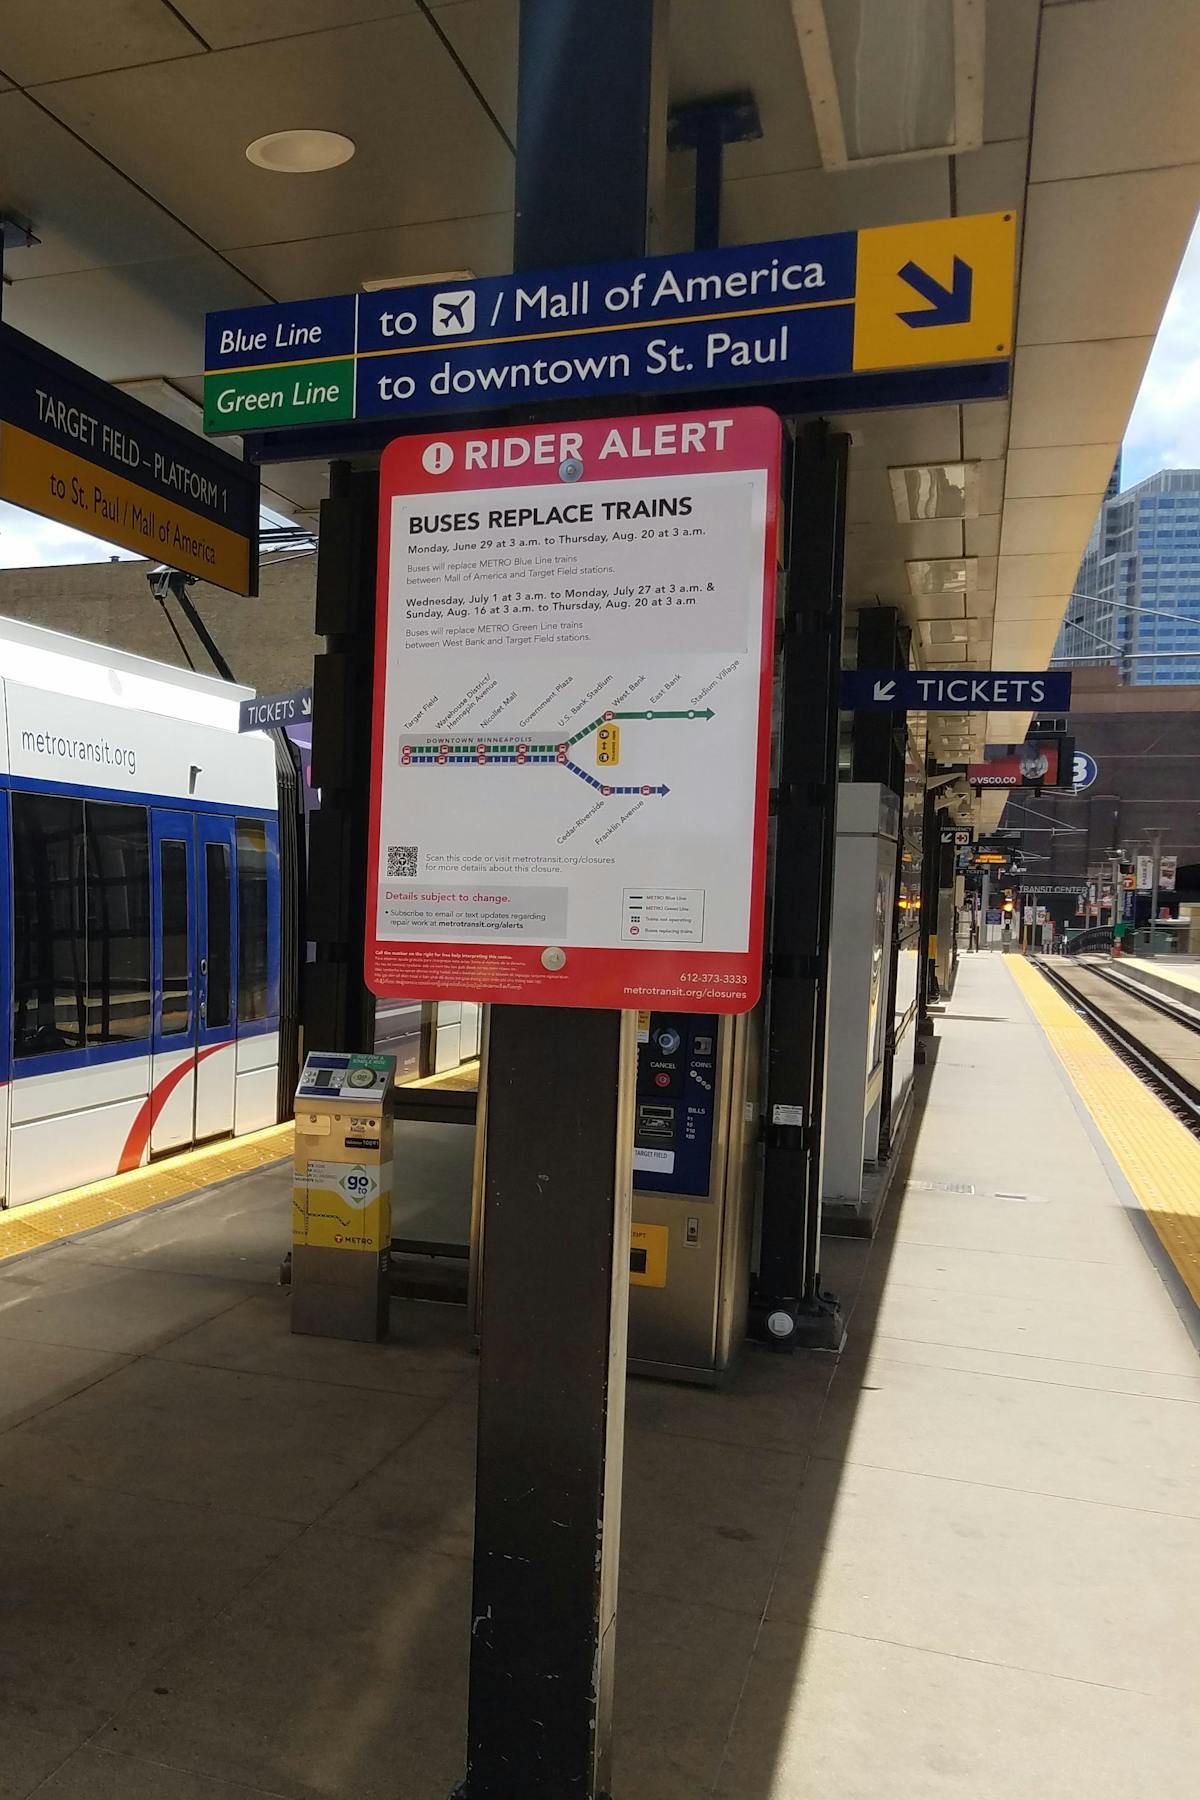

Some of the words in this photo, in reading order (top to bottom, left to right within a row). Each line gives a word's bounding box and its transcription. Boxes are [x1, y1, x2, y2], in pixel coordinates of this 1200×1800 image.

[220, 329, 267, 354] Blue
[275, 322, 322, 348] Line
[379, 309, 417, 337] to
[516, 279, 588, 322] Mall
[605, 270, 644, 313] of
[652, 255, 825, 306] America
[217, 389, 284, 414] Green
[292, 381, 340, 406] Line
[379, 373, 416, 400] to
[430, 349, 630, 396] downtown
[647, 336, 694, 374] St.
[707, 326, 788, 368] Paul
[36, 389, 98, 447] TARGET
[102, 426, 140, 468] FIELD
[154, 453, 218, 509] PLATFORM
[222, 490, 227, 513] 1
[464, 432, 584, 470] RIDER
[599, 419, 734, 460] ALERT
[49, 473, 66, 499] to
[71, 477, 88, 510] St.
[94, 487, 119, 525] Paul
[132, 505, 156, 538] Mall
[159, 519, 169, 542] of
[173, 522, 215, 564] America
[409, 514, 479, 534] BUSES
[489, 504, 593, 528] REPLACE
[602, 496, 693, 521] TRAINS
[407, 543, 449, 553] Monday,
[452, 542, 476, 550] June
[479, 539, 492, 548] 29
[558, 532, 608, 543] Thursday,
[611, 531, 637, 541] Aug.
[641, 529, 654, 538] 20
[657, 529, 668, 537] at
[405, 596, 465, 607] Wednesday,
[468, 593, 489, 605] July
[501, 593, 511, 603] at
[550, 591, 561, 601] to
[564, 587, 609, 600] Monday,
[613, 585, 634, 597] July
[638, 585, 651, 596] 27
[654, 585, 665, 596] at
[406, 608, 443, 619] Sunday,
[446, 605, 470, 617] Aug.
[474, 604, 486, 614] 16
[552, 600, 601, 611] Thursday,
[605, 597, 630, 609] Aug.
[634, 597, 648, 606] 20
[651, 598, 662, 606] at
[570, 698, 588, 715] Bank
[586, 674, 614, 699] Stadium
[611, 690, 631, 707] West
[628, 674, 646, 691] Bank
[649, 689, 666, 704] East
[664, 673, 681, 690] Bank
[690, 680, 718, 706] Stadium
[716, 660, 740, 681] Village
[917, 680, 1046, 702] TICKETS
[248, 700, 295, 725] TICKETS
[404, 711, 424, 730] Target
[422, 695, 439, 712] Field
[435, 698, 468, 729] Warehouse
[446, 702, 476, 730] Hennepin
[475, 680, 497, 703] Avenue
[480, 706, 505, 729] Nicollet
[502, 691, 518, 706] Mall
[520, 691, 557, 728] Government
[555, 676, 573, 692] Plaza
[21, 729, 136, 774] metrotransit.org
[977, 776, 1016, 784] VSCO.CO
[556, 800, 605, 845] Cedar-Riverside
[594, 822, 621, 846] Franklin
[620, 800, 644, 823] Avenue
[385, 891, 418, 900] Details
[420, 892, 455, 902] subject
[472, 893, 510, 904] change.
[623, 985, 747, 1000] metrotransit.org/closures
[680, 972, 748, 985] 612-373-3333
[347, 1175, 369, 1190] go
[345, 1236, 373, 1246] METRO
